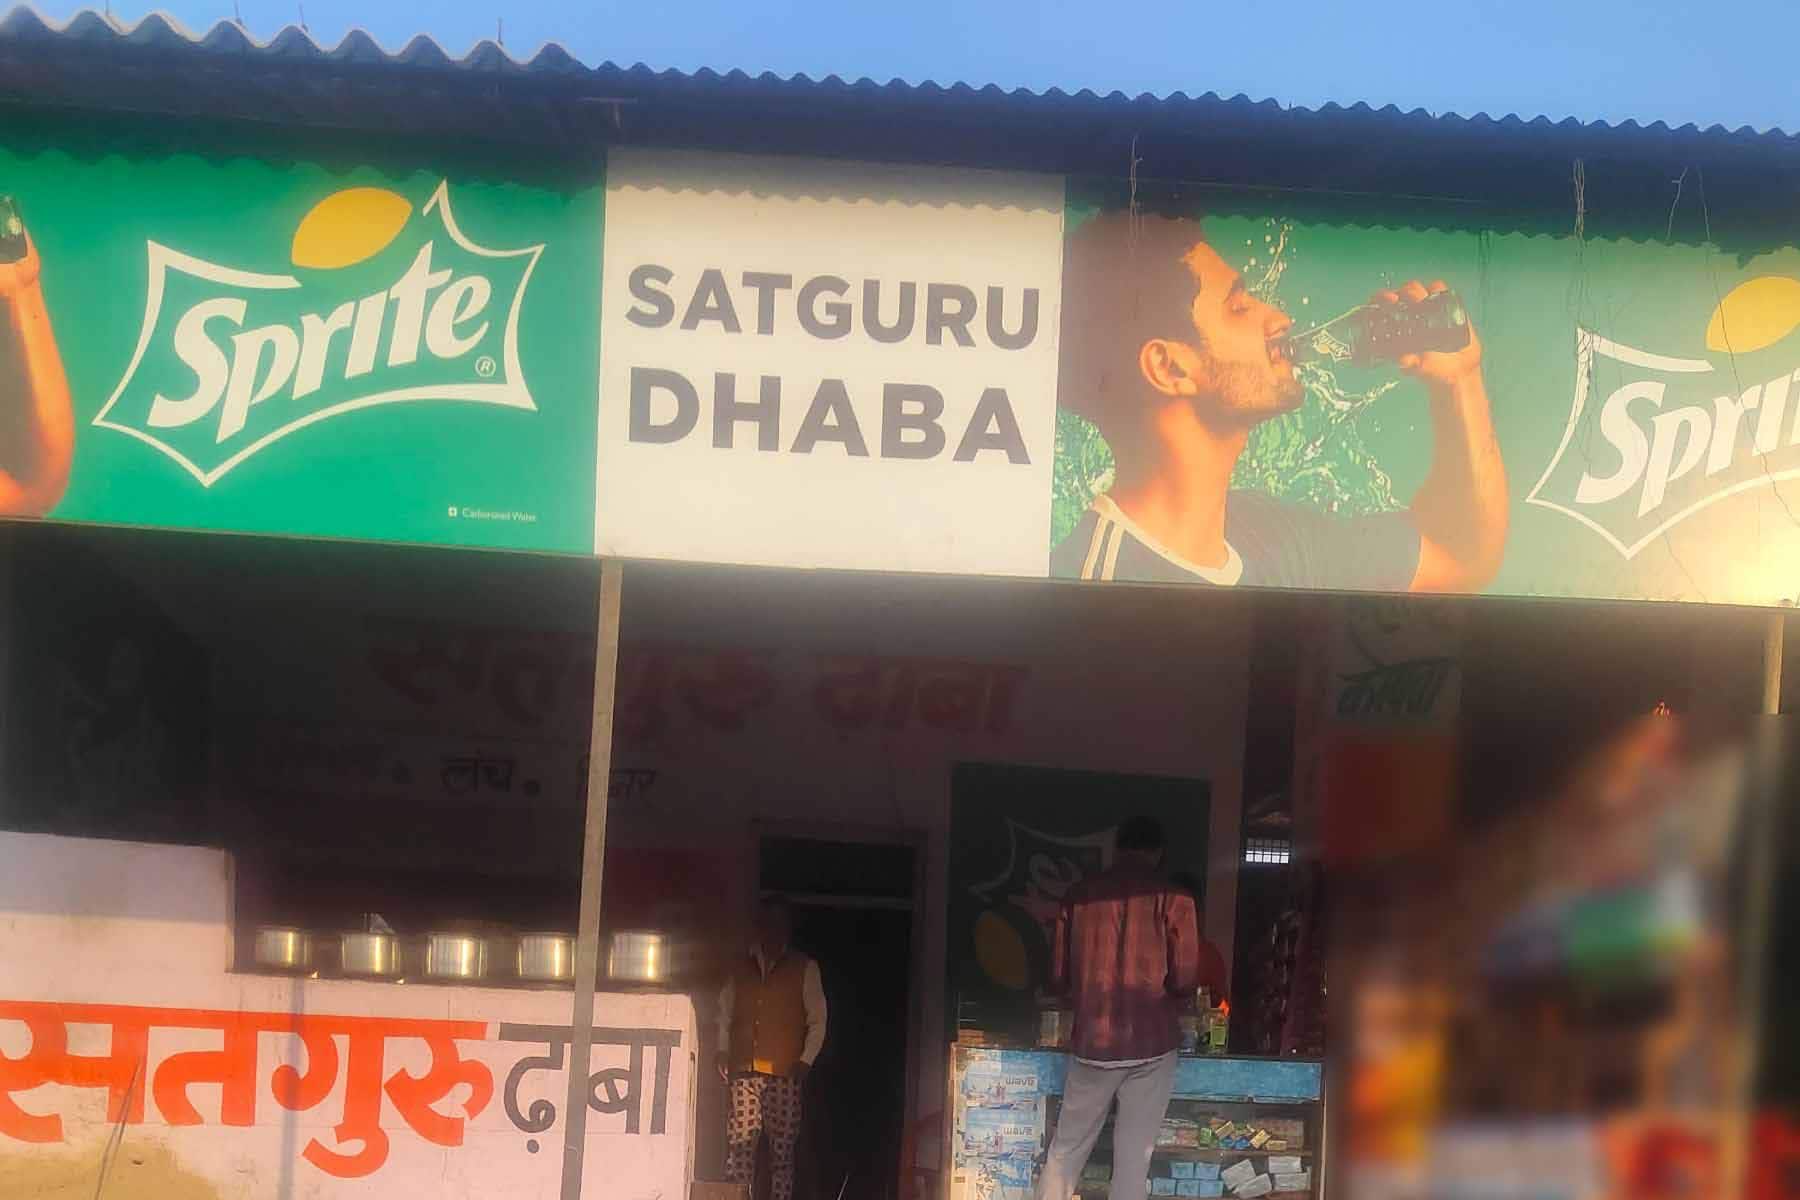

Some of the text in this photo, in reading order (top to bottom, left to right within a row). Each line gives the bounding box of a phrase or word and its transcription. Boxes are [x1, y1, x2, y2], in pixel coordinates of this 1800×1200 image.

[146, 240, 492, 444] Sprite
[625, 264, 1040, 350] SATGURU
[628, 367, 1031, 465] DHABA
[1575, 367, 1800, 519] Spri
[0, 1000, 494, 1179] सतगुरु
